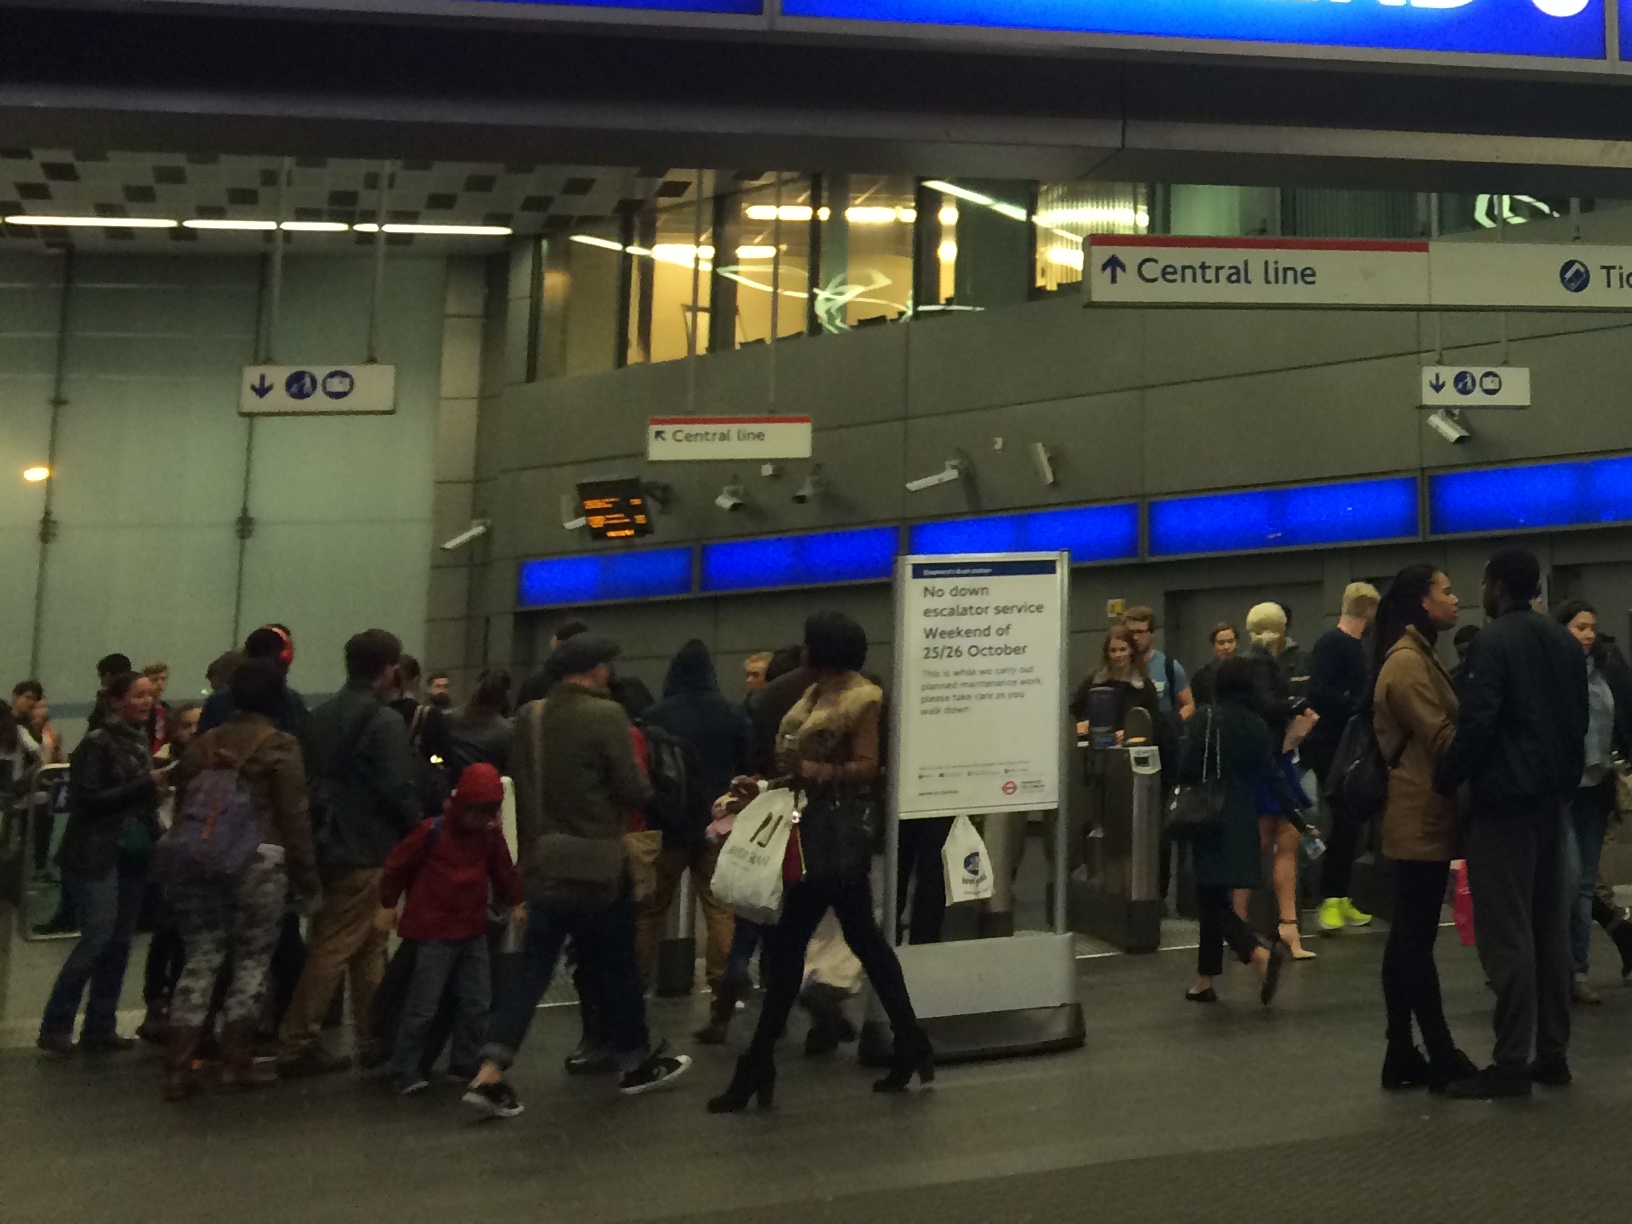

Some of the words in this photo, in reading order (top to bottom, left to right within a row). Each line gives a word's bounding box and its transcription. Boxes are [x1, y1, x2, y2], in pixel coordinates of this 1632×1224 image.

[1137, 258, 1252, 285] Central
[1264, 260, 1317, 285] line
[671, 429, 731, 443] Central
[736, 428, 766, 442] line
[923, 586, 945, 598] No
[948, 585, 990, 598] down
[923, 604, 989, 617] escalator
[994, 602, 1044, 615] service
[923, 624, 991, 639] Weekend
[996, 623, 1012, 637] of
[923, 646, 963, 660] 25/26
[967, 644, 1028, 658] October
